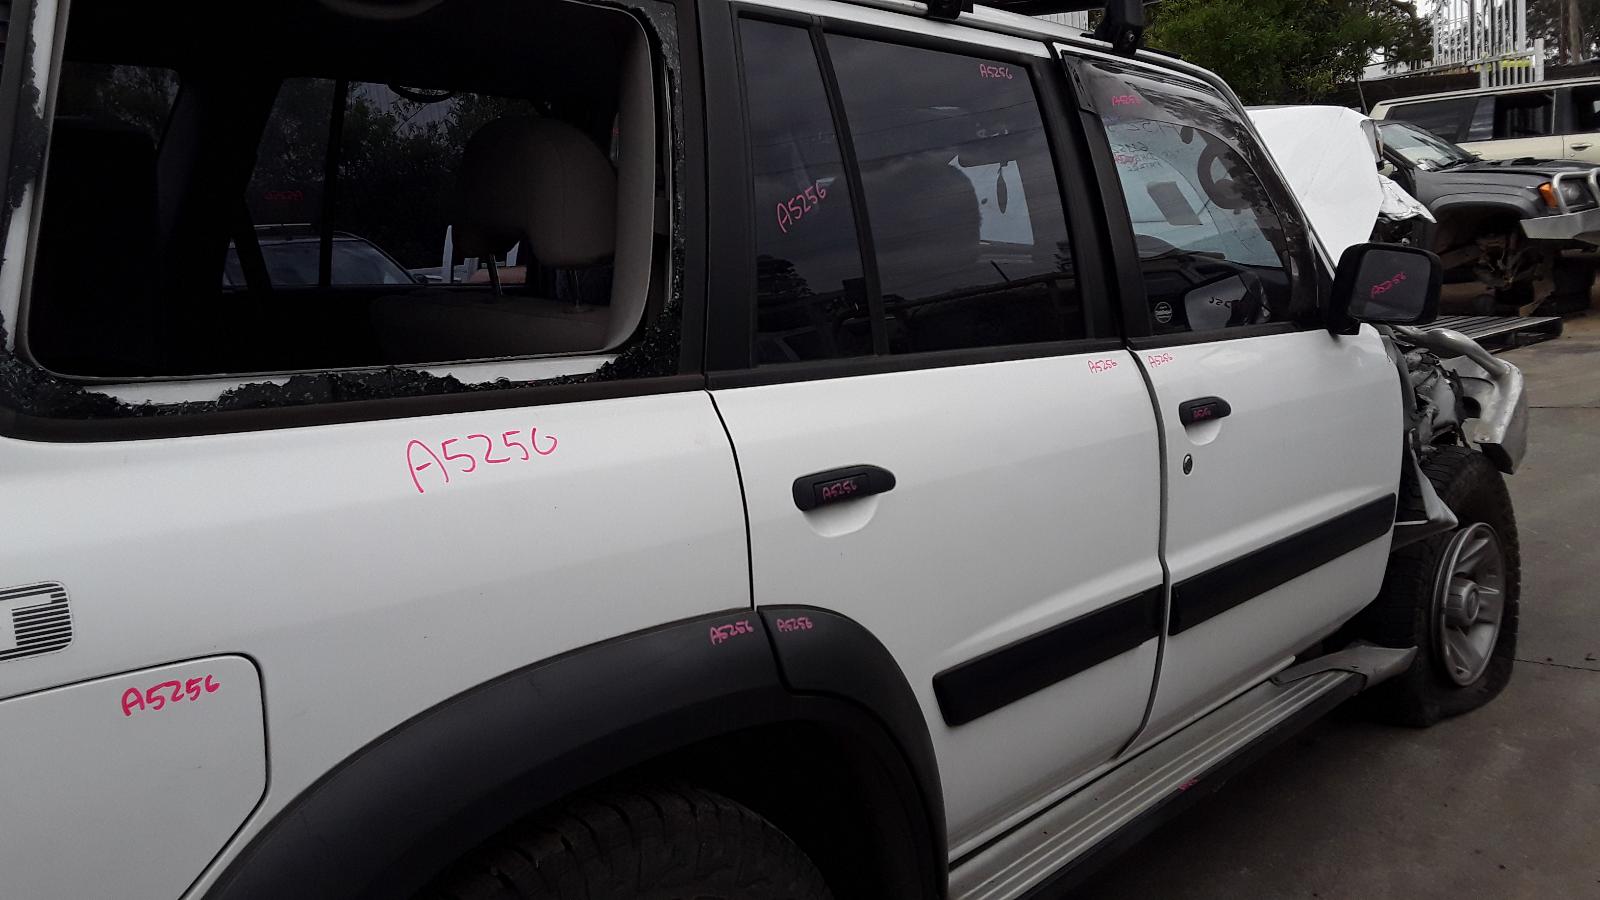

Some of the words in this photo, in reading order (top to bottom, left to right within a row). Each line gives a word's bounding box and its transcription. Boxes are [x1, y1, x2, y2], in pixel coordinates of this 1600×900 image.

[979, 63, 1013, 80] A5256
[776, 180, 827, 233] A5256
[1087, 359, 1118, 374] A5256
[406, 427, 559, 494] A5256
[822, 480, 857, 500] A5256
[710, 620, 754, 645] A5256
[776, 617, 813, 632] A5256
[121, 674, 220, 717] A5256
